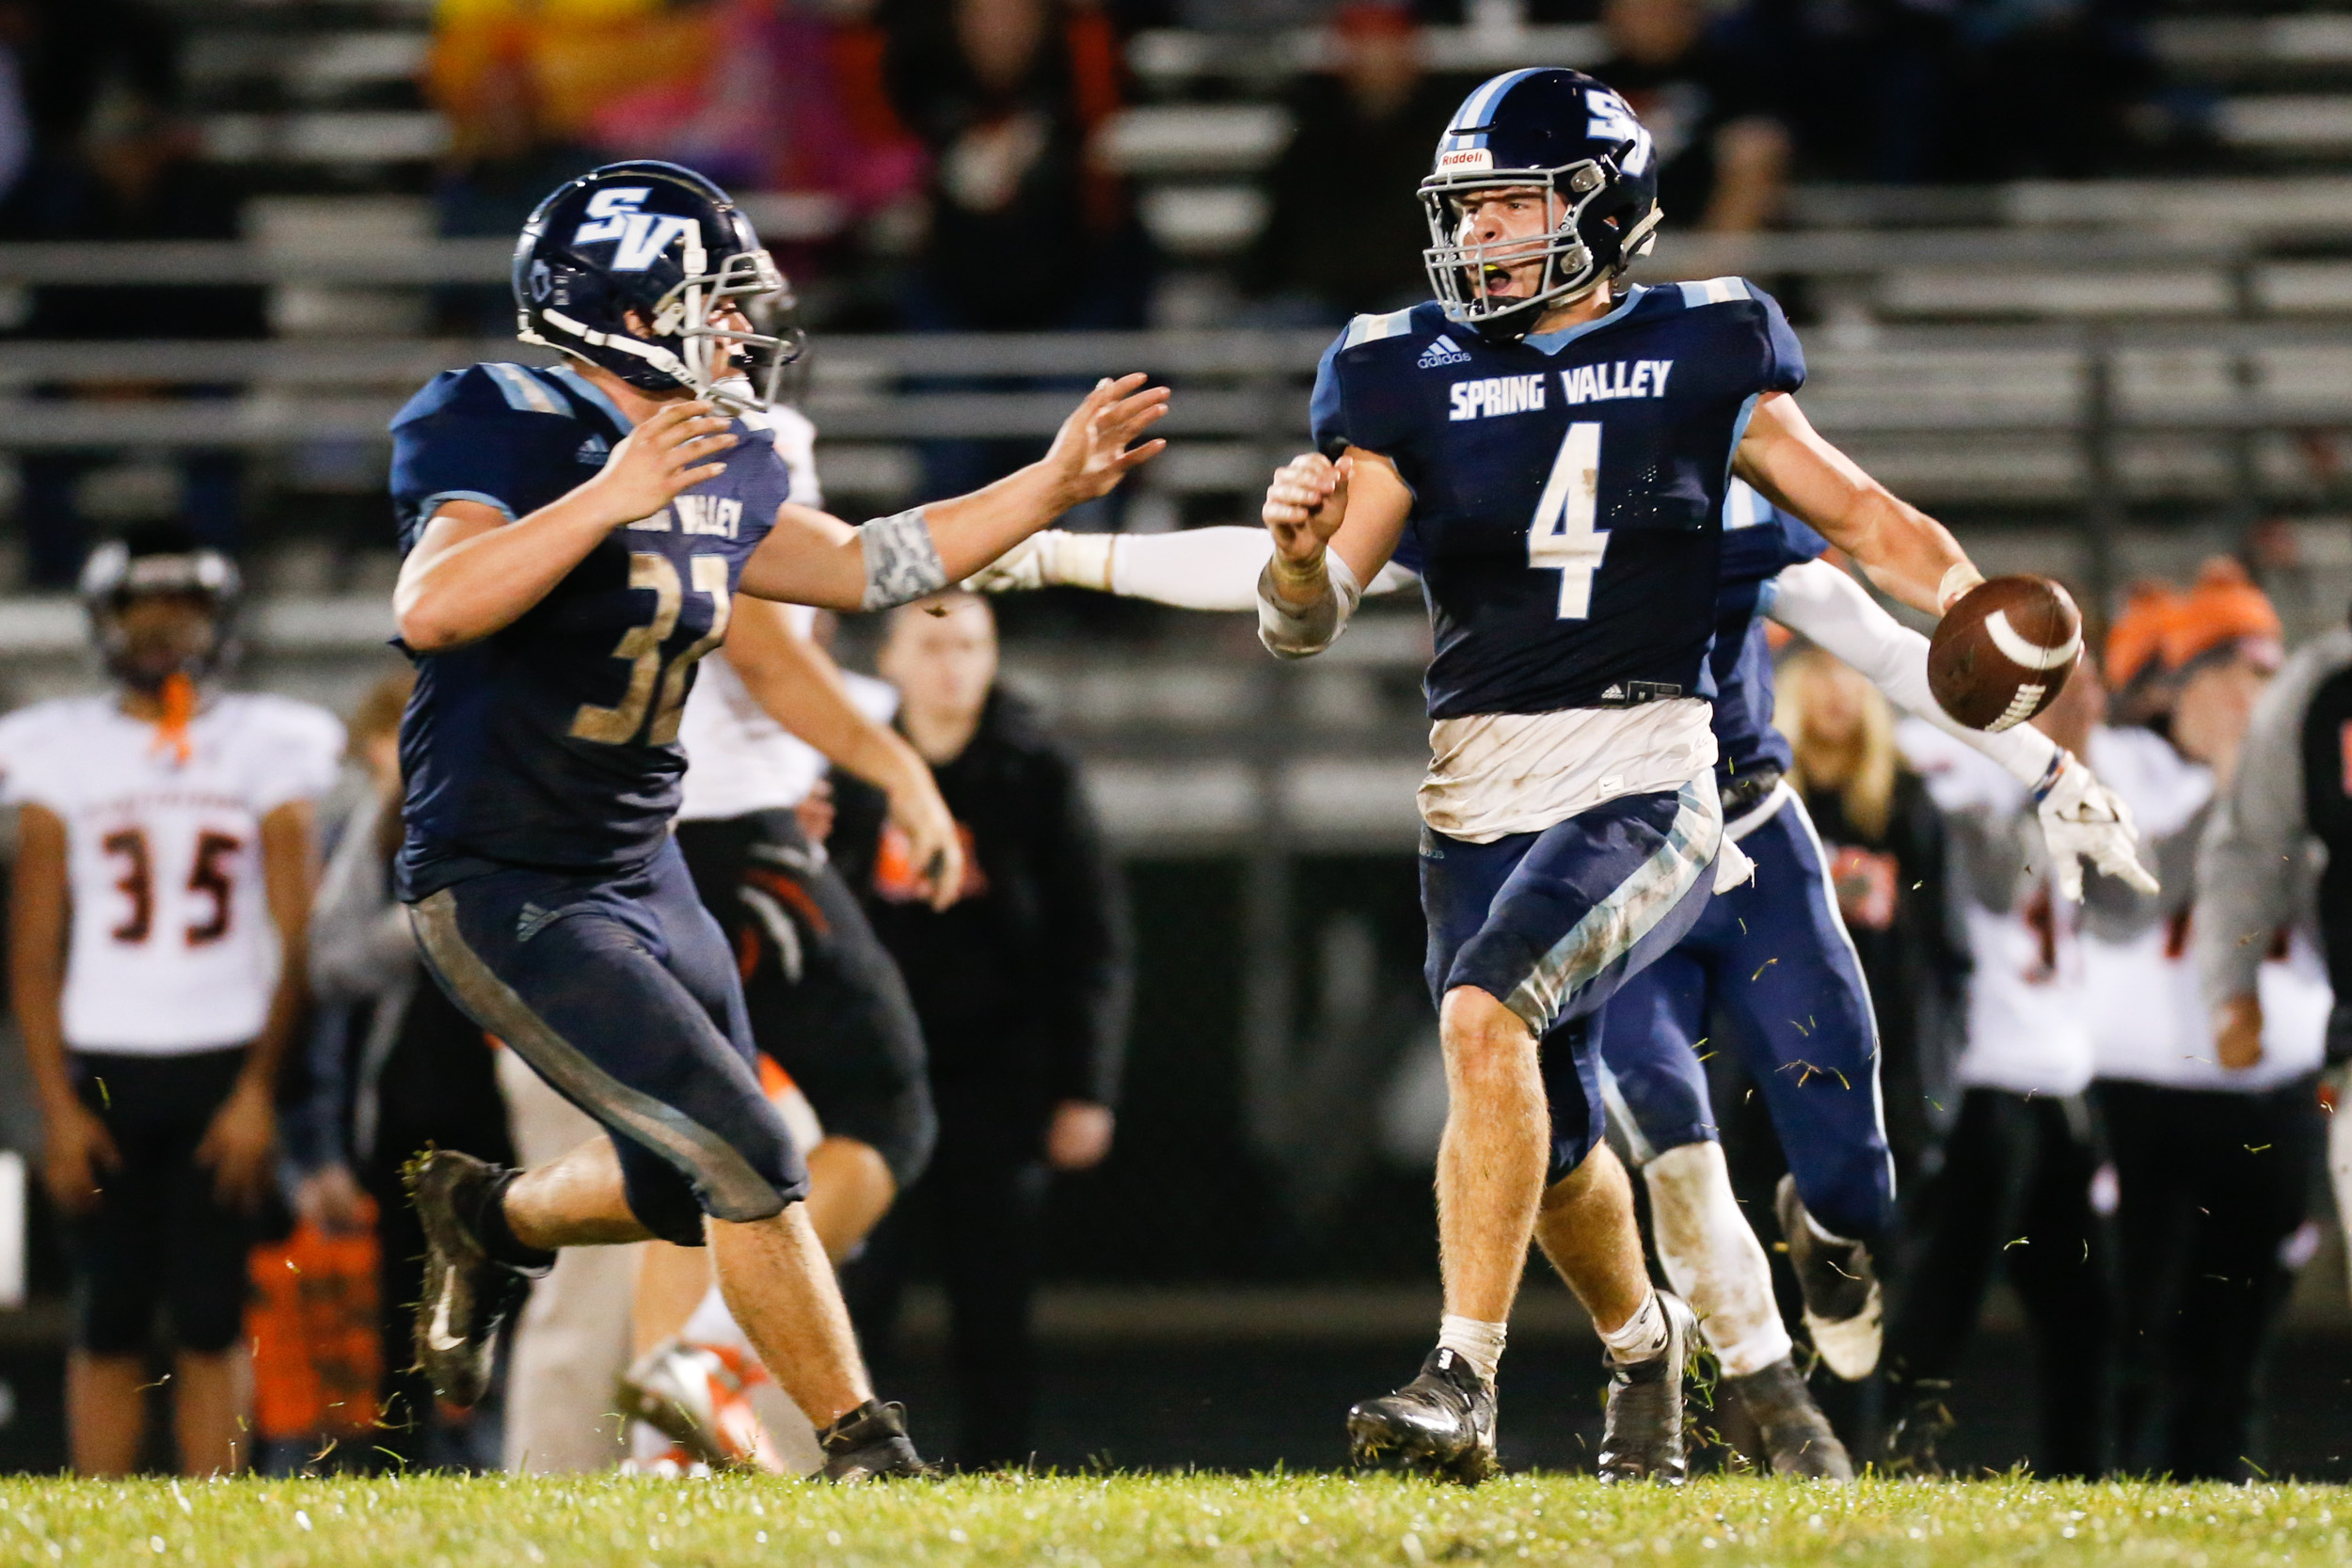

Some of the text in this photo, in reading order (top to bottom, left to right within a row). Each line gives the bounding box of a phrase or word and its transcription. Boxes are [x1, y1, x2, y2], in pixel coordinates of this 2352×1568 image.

[1442, 151, 1483, 166] Riddell
[572, 187, 692, 272] SV
[1417, 352, 1471, 369] adidas
[1449, 359, 1674, 421] SPRING VALLEY
[1526, 421, 1613, 620] 4
[567, 550, 732, 746] 32
[102, 828, 241, 945] 35
